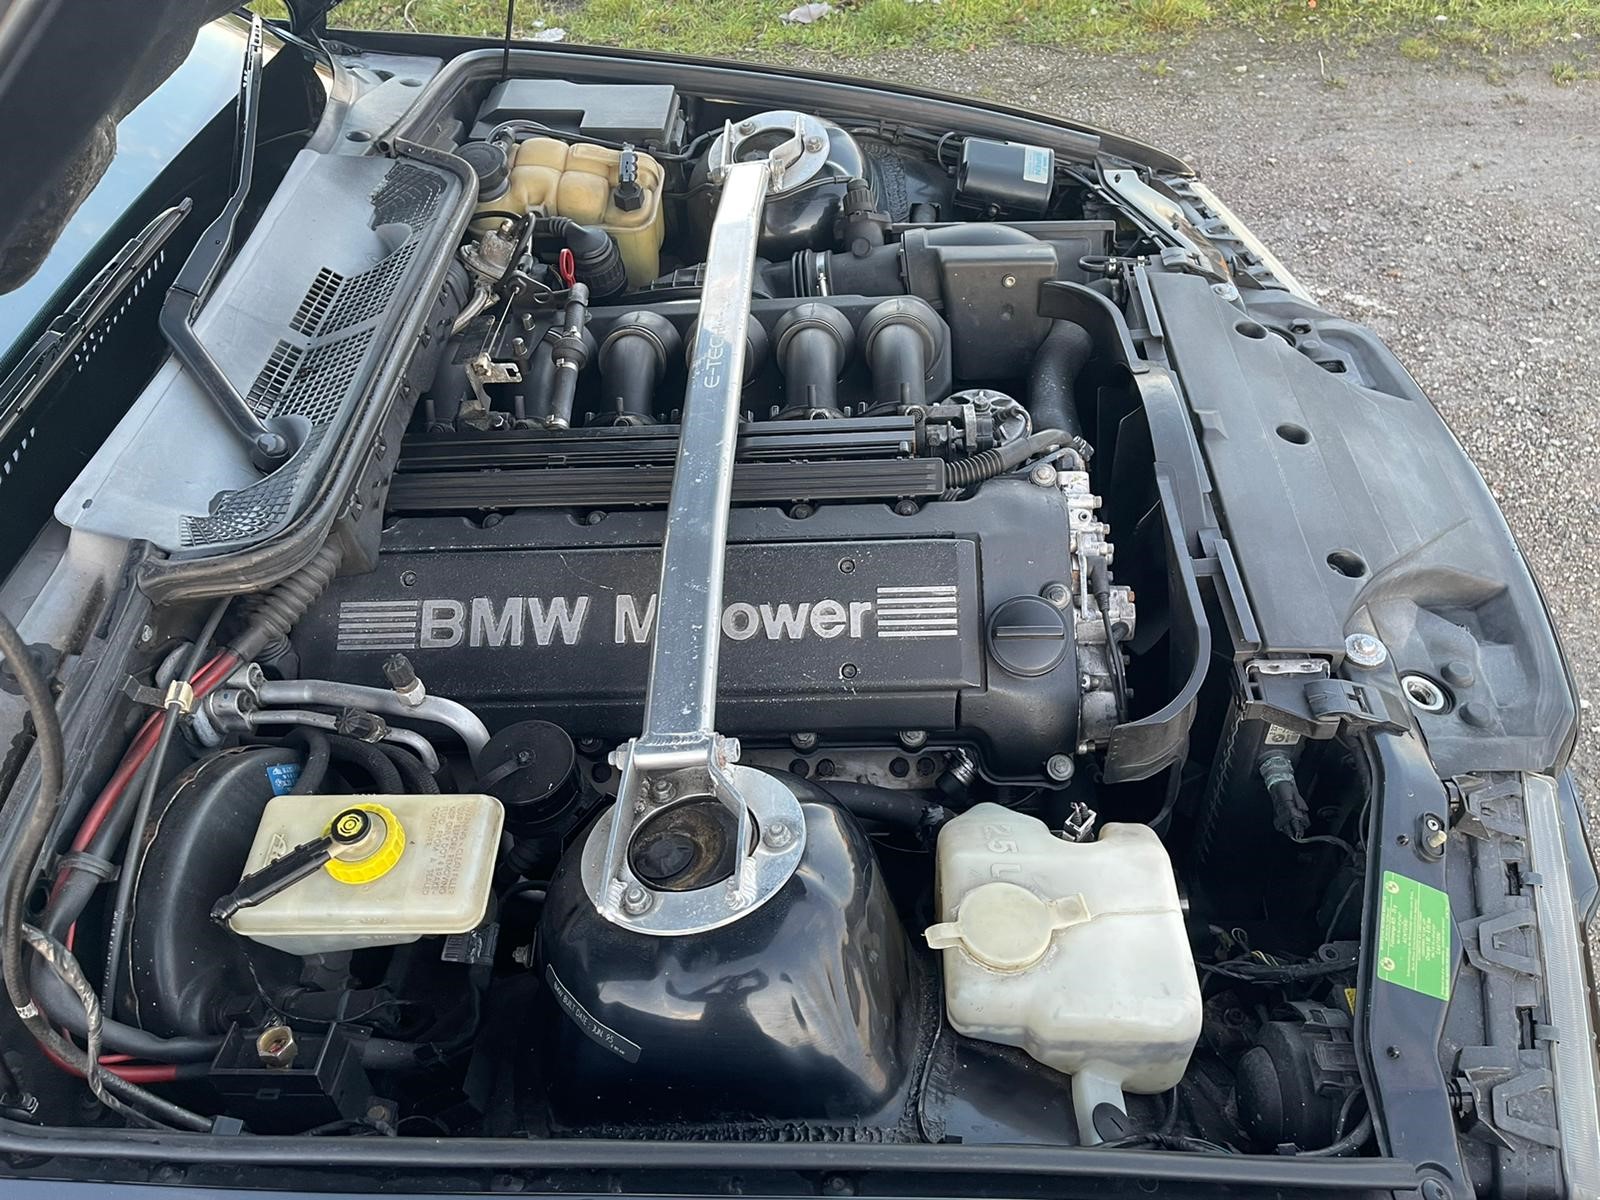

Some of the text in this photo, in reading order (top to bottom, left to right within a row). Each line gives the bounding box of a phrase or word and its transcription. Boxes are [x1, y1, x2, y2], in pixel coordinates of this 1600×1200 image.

[420, 596, 589, 648] BMW
[721, 599, 871, 642] ower
[562, 995, 576, 1011] BUILT
